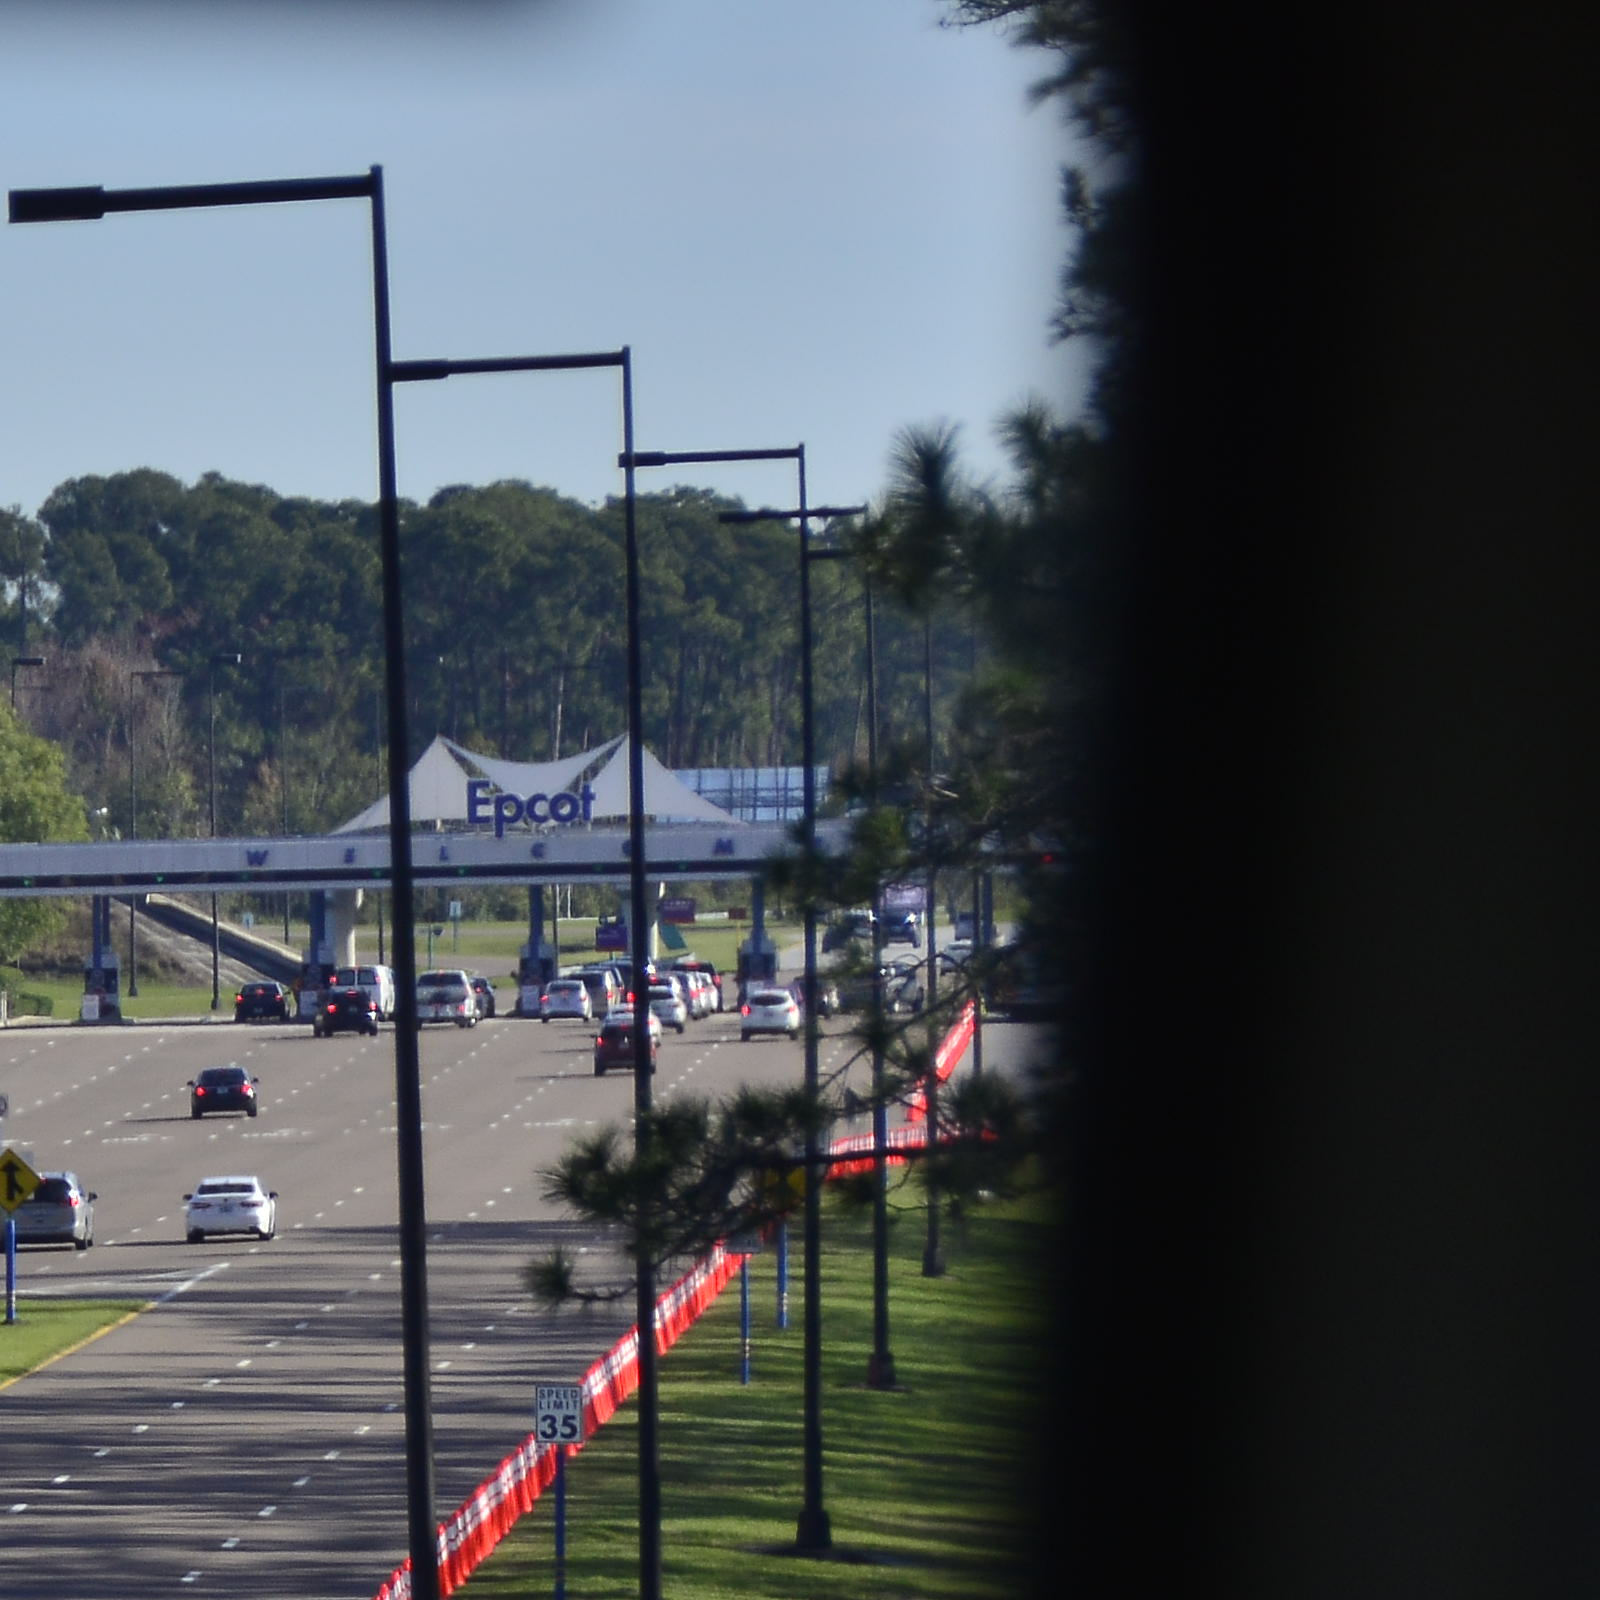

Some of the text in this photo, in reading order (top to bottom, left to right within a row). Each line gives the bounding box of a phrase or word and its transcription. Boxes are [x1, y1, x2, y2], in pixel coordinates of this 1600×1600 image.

[467, 780, 596, 838] Epcot
[539, 1389, 578, 1399] SPEED
[539, 1401, 578, 1410] LIMIT
[540, 1414, 578, 1439] 35
